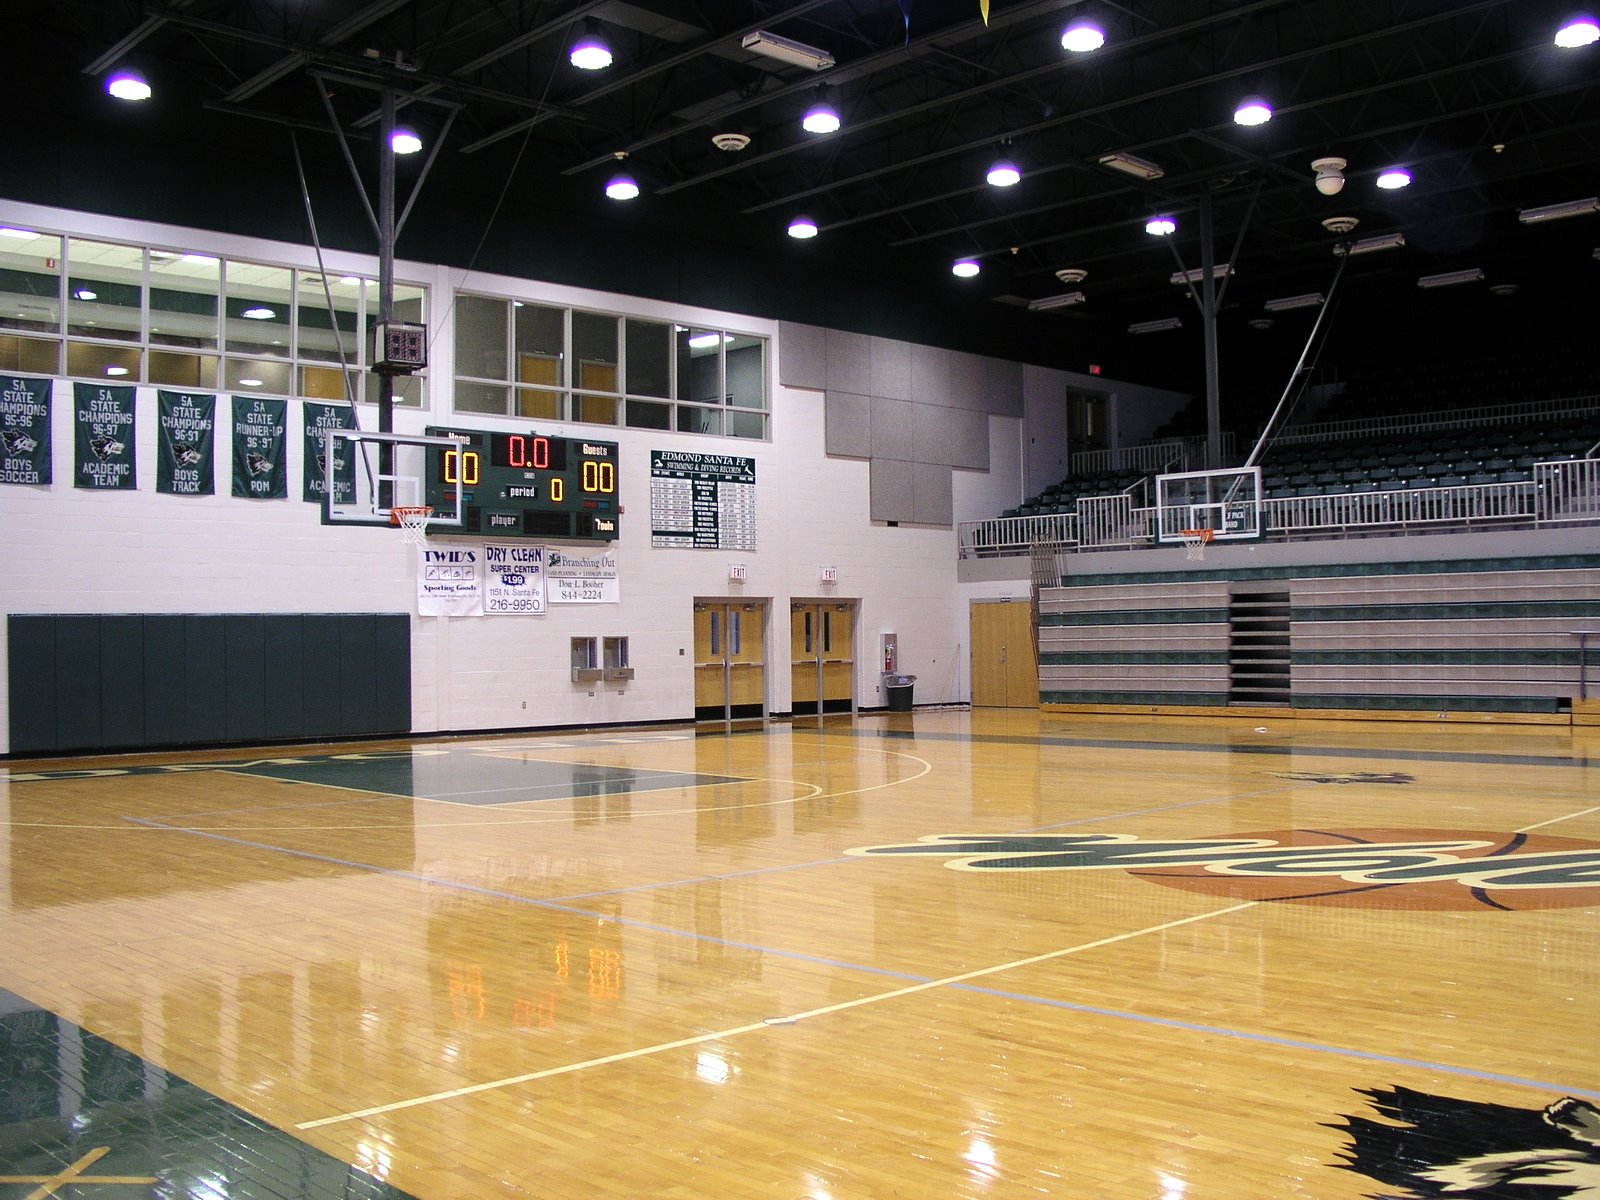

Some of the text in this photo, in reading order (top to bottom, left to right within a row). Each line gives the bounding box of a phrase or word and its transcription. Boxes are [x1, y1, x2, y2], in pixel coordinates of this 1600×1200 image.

[4, 391, 34, 404] STATE
[91, 400, 121, 412] STATE
[80, 411, 133, 424] CHAMPIONS
[173, 407, 202, 419] STATE
[247, 413, 274, 425] STATE
[5, 415, 32, 427] 95-96
[162, 416, 212, 430] CHAMPIONS
[316, 417, 342, 429] STATE
[93, 424, 118, 435] 96-97
[175, 430, 198, 441] 96-97
[236, 423, 283, 437] RUNNER-UP
[247, 437, 272, 449] 96-97
[509, 436, 548, 468] 0.0
[583, 444, 608, 456] Guests
[5, 459, 32, 470] BOYS
[661, 451, 747, 466] EDMOND SANTA FE
[83, 463, 130, 475] ACADEMIC
[666, 462, 694, 471] SWIMMING
[700, 464, 719, 473] DIVING
[719, 466, 742, 474] RECORDS
[0, 471, 39, 483] SOCCER
[93, 475, 119, 486] TEAM
[174, 469, 198, 480] BOYS
[583, 461, 614, 493] 00
[172, 481, 201, 492] TRACK
[251, 481, 269, 491] POM
[551, 478, 563, 502] 0
[510, 487, 535, 498] period
[491, 514, 516, 527] player
[423, 551, 476, 562] TWID'S
[486, 547, 542, 562] DRY CLEAN
[562, 556, 615, 569] Branching Out
[490, 565, 540, 573] SUPER CENTER
[503, 575, 524, 583] $1.99
[561, 590, 602, 599] 844-2224
[490, 599, 540, 610] 216-9950
